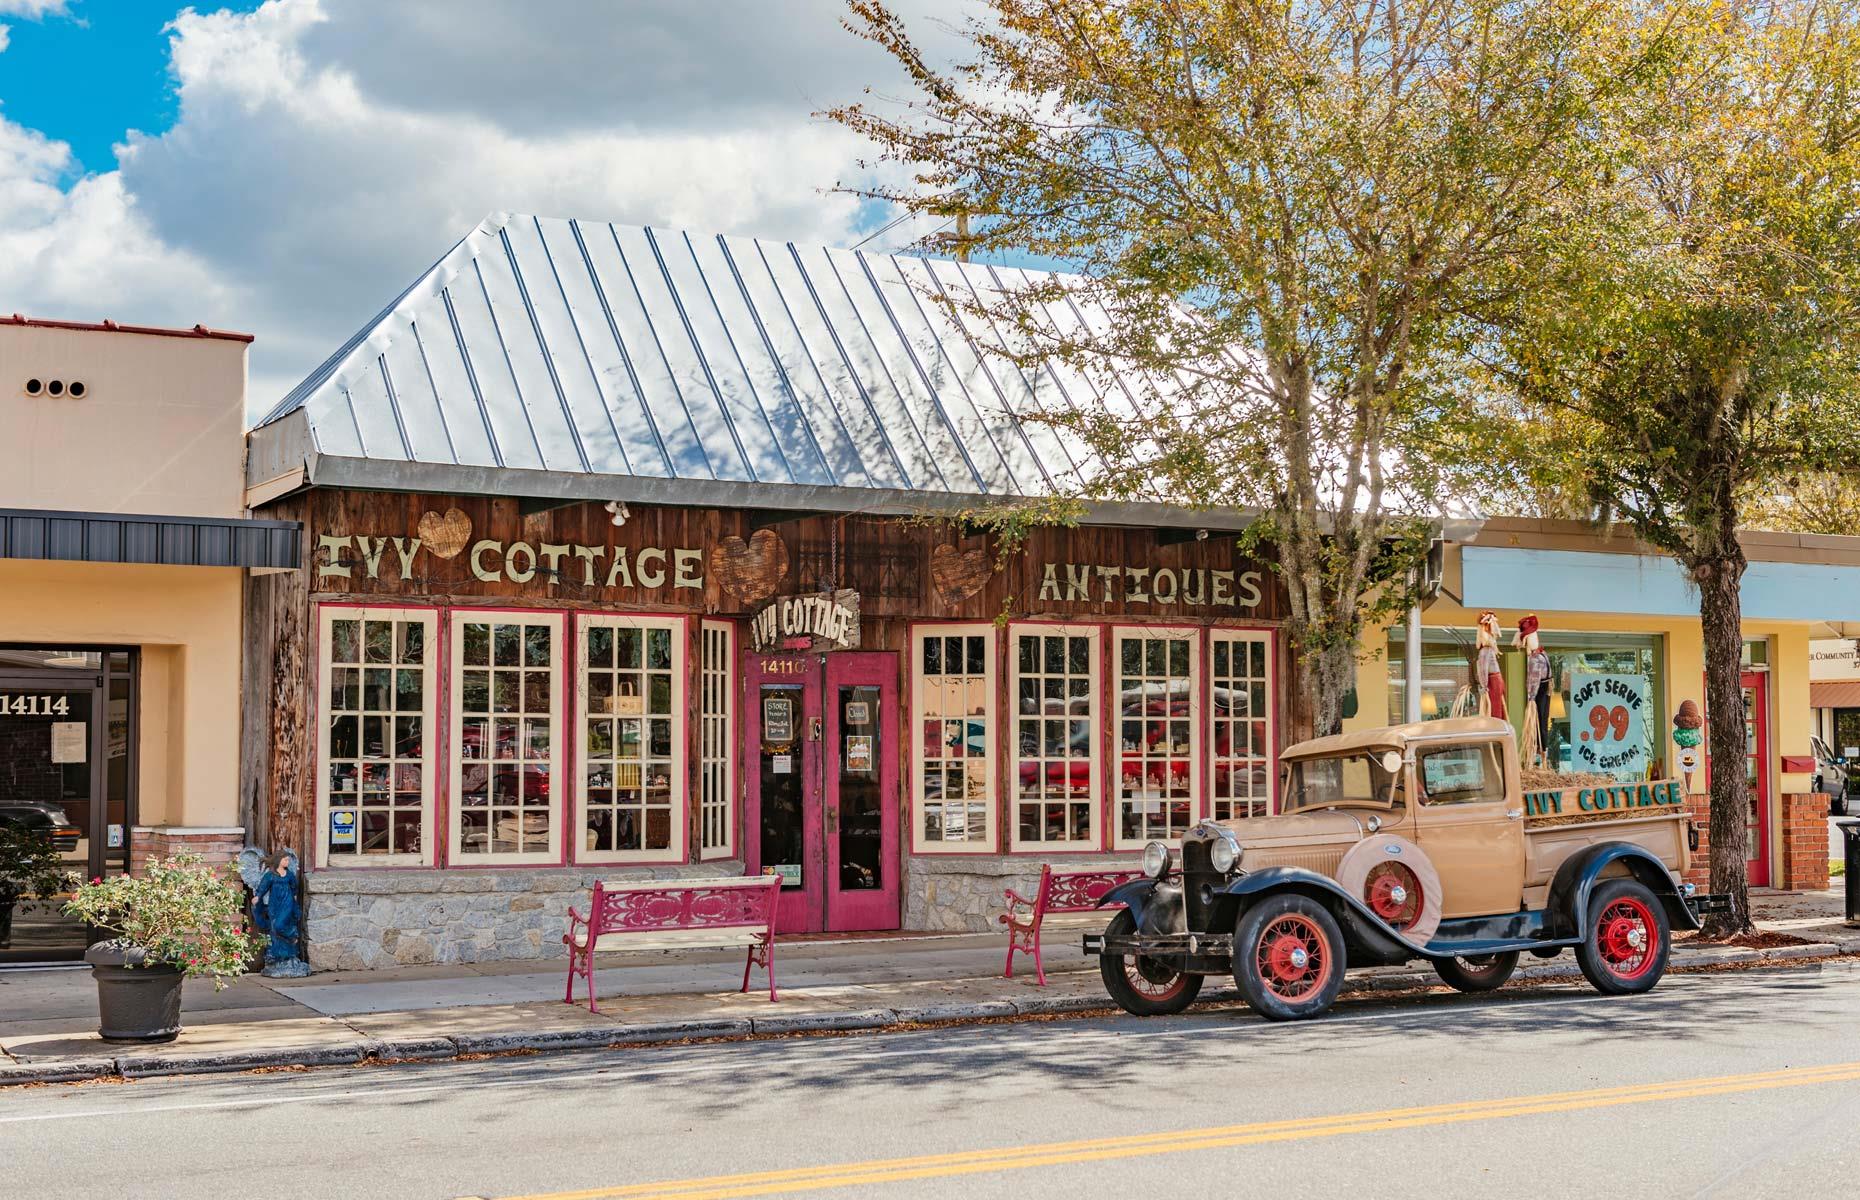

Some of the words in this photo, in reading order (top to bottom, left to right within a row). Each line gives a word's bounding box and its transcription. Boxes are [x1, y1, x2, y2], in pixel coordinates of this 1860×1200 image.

[319, 534, 422, 580] IVY
[470, 539, 703, 589] COTTAGE
[1038, 563, 1262, 608] ANTIQUES
[783, 597, 853, 647] COTTAGE
[0, 695, 70, 715] 14114
[1574, 680, 1601, 708] SOFT
[1605, 679, 1642, 710] SERVE
[1580, 705, 1630, 741] .99
[1579, 745, 1597, 764] ICE
[1600, 745, 1640, 769] CREAM
[1525, 791, 1563, 816] IVY
[1578, 782, 1683, 811] COTTAGE
